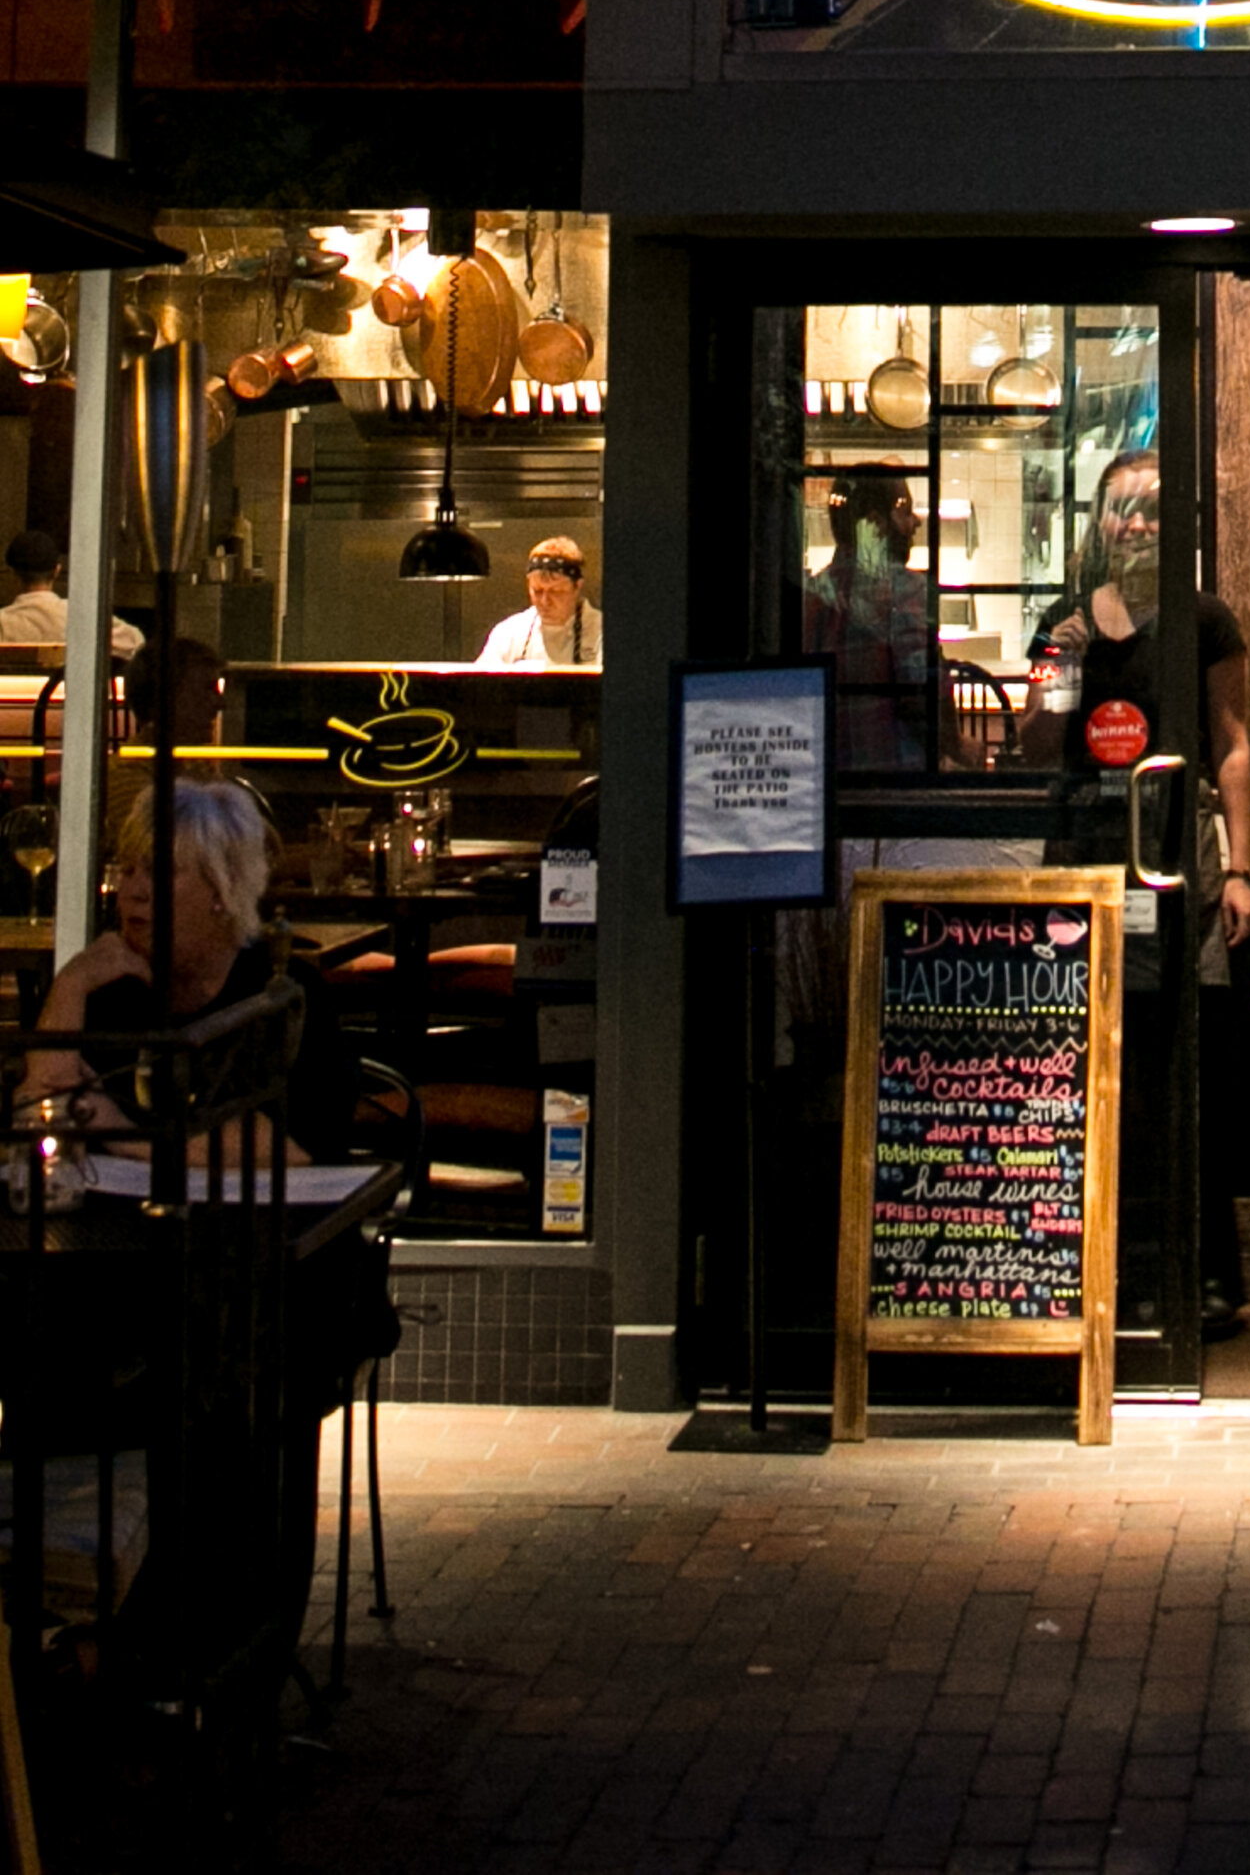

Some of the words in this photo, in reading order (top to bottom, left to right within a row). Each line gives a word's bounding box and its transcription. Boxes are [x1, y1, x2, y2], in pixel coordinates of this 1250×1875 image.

[711, 726, 760, 740] PLEASE
[768, 726, 793, 738] SEE
[694, 741, 757, 755] HOSTESS
[762, 739, 810, 752] INSIDE
[731, 754, 748, 766] TO
[754, 754, 772, 766] BE
[711, 768, 766, 780] SEATED
[771, 767, 791, 780] ON
[714, 783, 739, 796] THE
[746, 782, 788, 794] PATIO
[714, 797, 756, 809] Thank
[762, 798, 788, 810] you
[547, 849, 590, 859] PROUD
[884, 957, 994, 1007] HAPPY
[1004, 961, 1089, 1013] HOUR
[1020, 1051, 1076, 1078] well
[878, 1099, 989, 1116] BRUSCHETTA
[1018, 1107, 1076, 1124] CHIPS
[987, 1125, 1055, 1144] BEERS
[944, 1166, 999, 1178] STEAK
[1002, 1165, 1061, 1179] TARTAR
[903, 1165, 983, 1200] house
[988, 1177, 1080, 1202] wines
[875, 1202, 928, 1221] FRIED
[931, 1206, 1006, 1224] OYSTERS
[1033, 1202, 1060, 1216] BLT
[874, 1223, 939, 1237] SHRIMP
[944, 1224, 1021, 1240] COCKTAIL
[874, 1239, 926, 1258] well
[935, 1240, 1067, 1265] martinis
[902, 1259, 1080, 1283] manhattans
[894, 1281, 1027, 1296] SANGRIA
[877, 1296, 949, 1317] cheese
[961, 1298, 1011, 1318] plate
